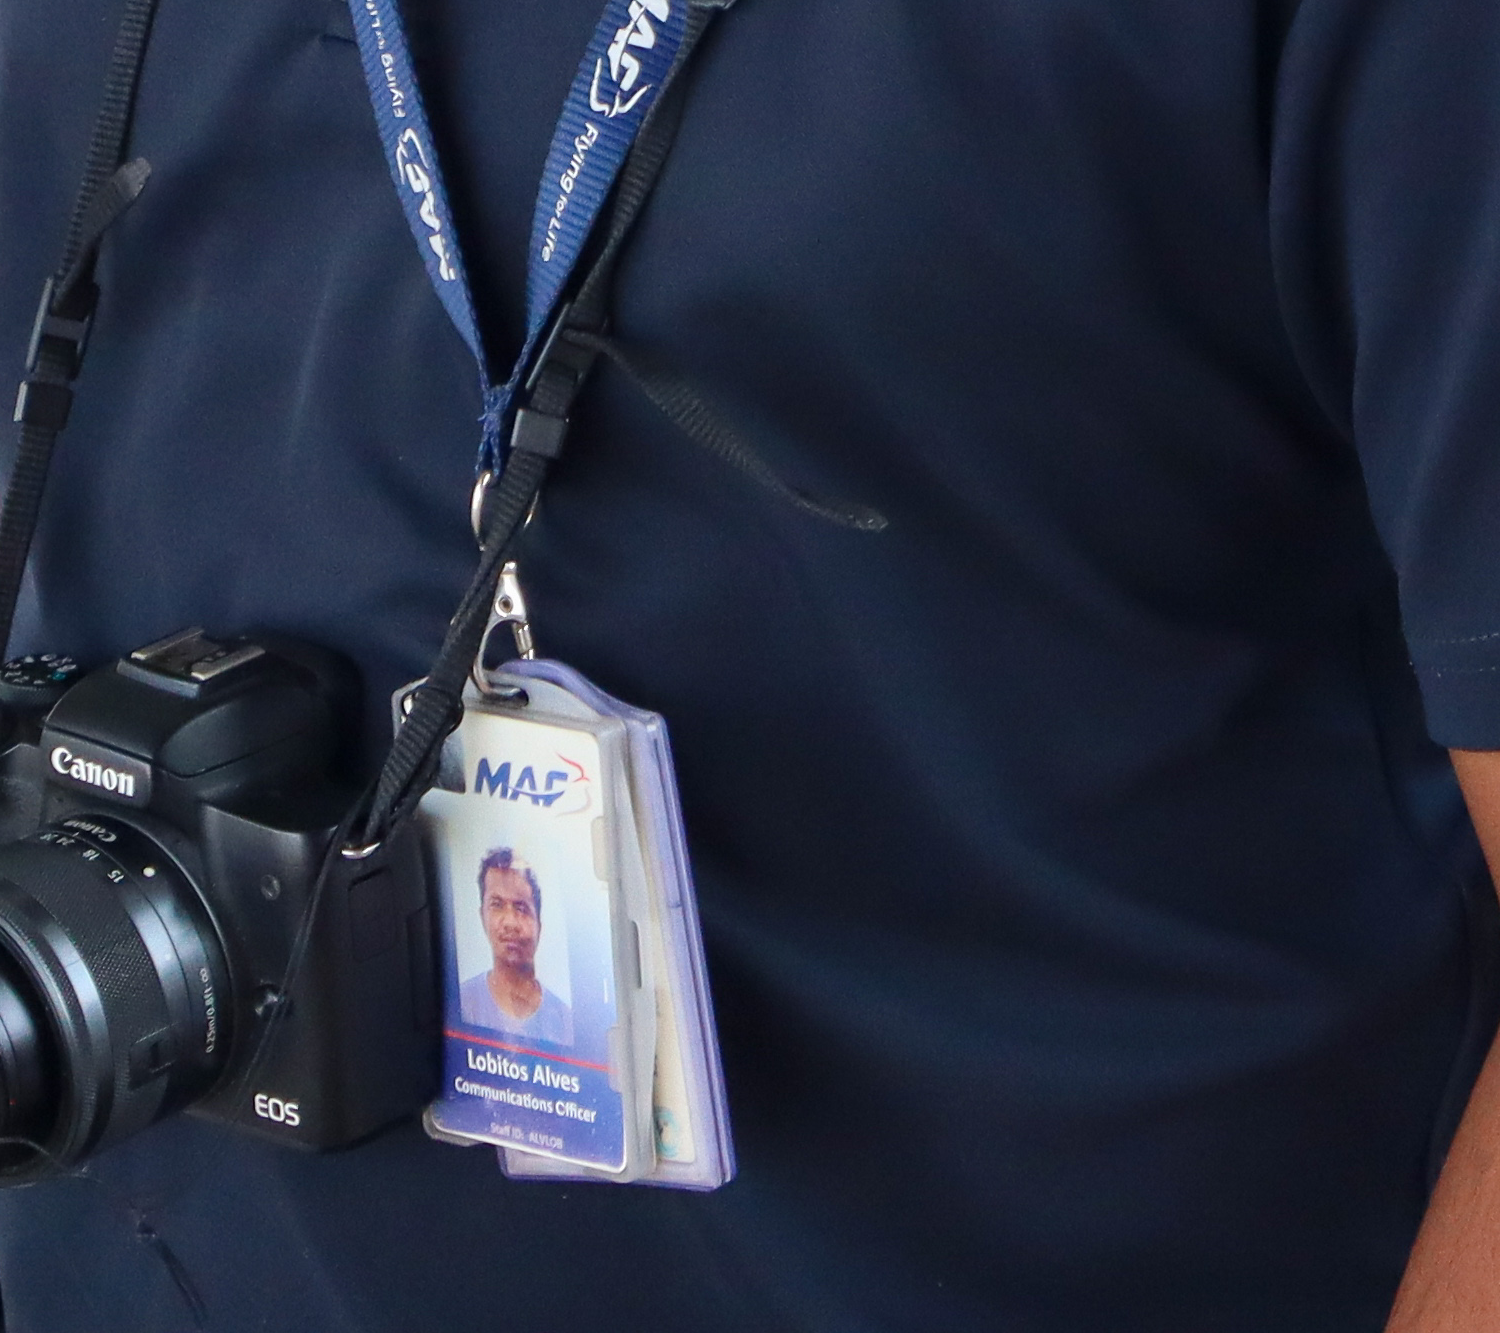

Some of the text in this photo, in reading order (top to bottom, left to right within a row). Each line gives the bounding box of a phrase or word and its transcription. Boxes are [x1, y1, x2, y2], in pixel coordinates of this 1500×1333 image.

[380, 52, 406, 118] Flying
[540, 121, 599, 263] Flying for Life
[51, 745, 135, 797] Canon
[474, 757, 569, 808] MAF
[106, 869, 125, 884] 15
[466, 1047, 581, 1094] Lobitos Alves
[253, 1092, 301, 1127] EOS
[454, 1076, 598, 1124] Communications Officer
[489, 1121, 511, 1137] Staff
